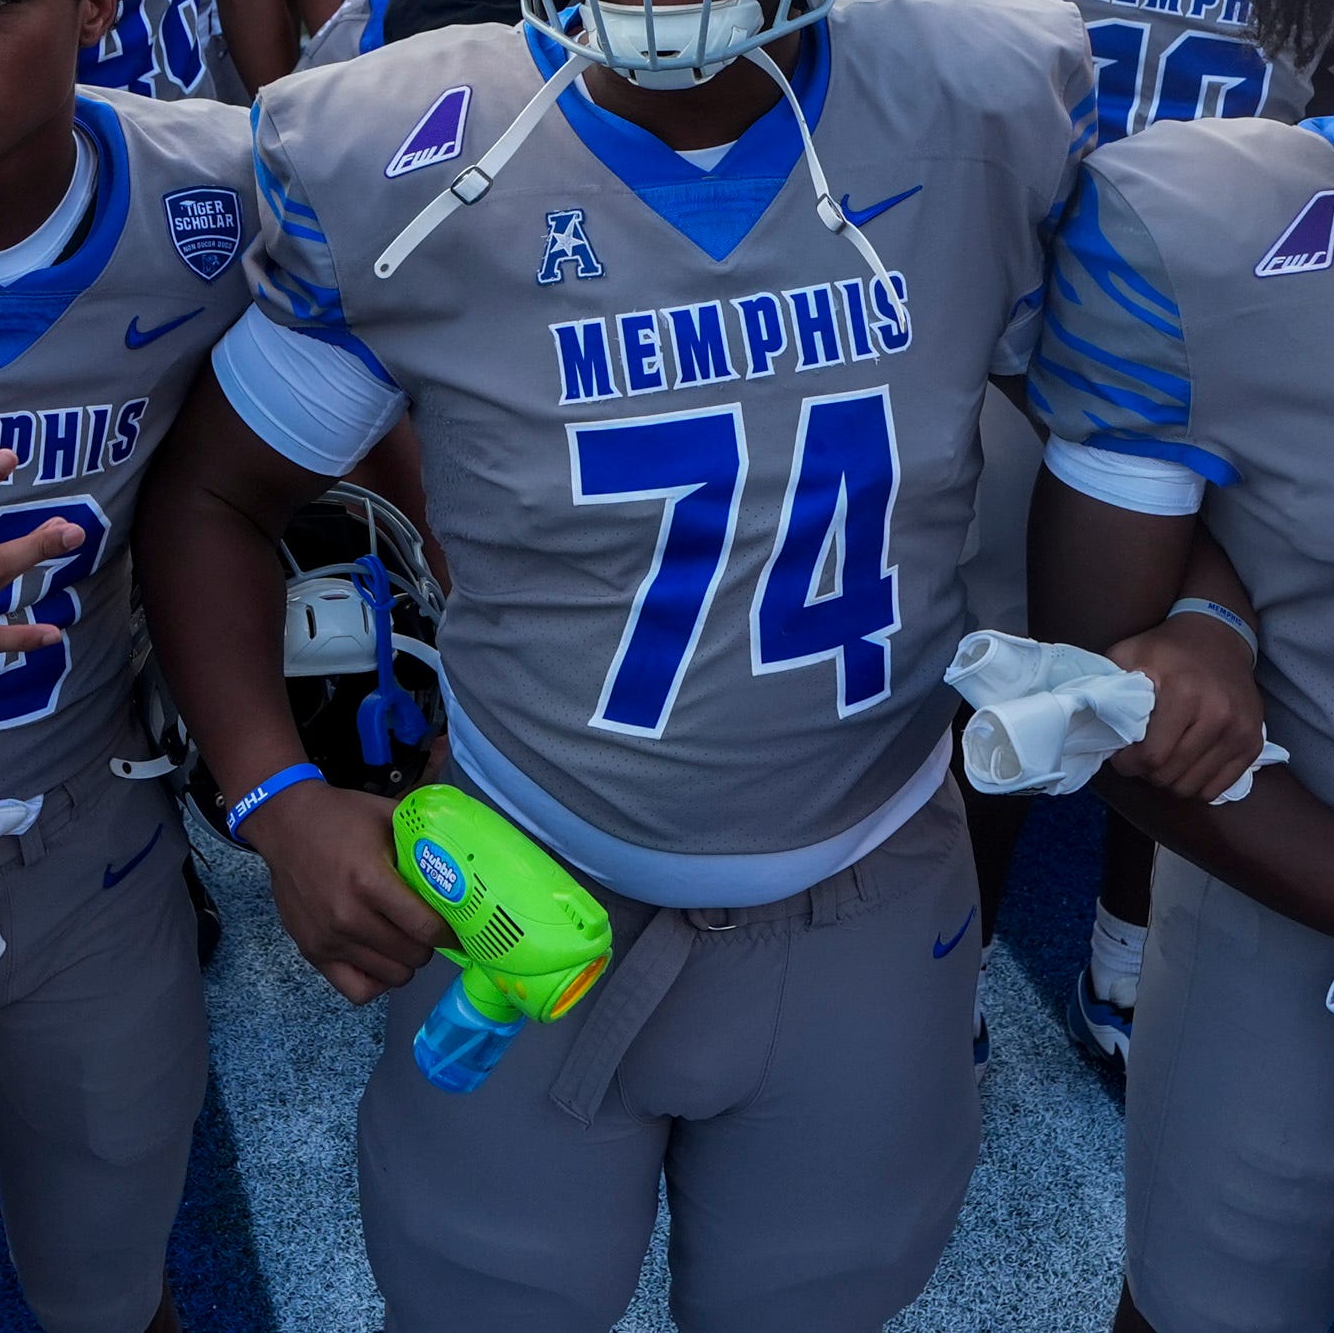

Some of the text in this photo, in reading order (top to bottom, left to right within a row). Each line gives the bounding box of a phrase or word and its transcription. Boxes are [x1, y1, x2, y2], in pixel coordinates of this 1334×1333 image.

[174, 213, 235, 231] SCHOLAR
[186, 200, 225, 217] TIGER
[548, 270, 913, 406] MEMPHIS
[563, 384, 901, 740] 74
[1207, 602, 1244, 627] MEMPHIS
[235, 786, 269, 818] THE
[419, 858, 453, 893] STORM
[422, 845, 457, 883] bubble
